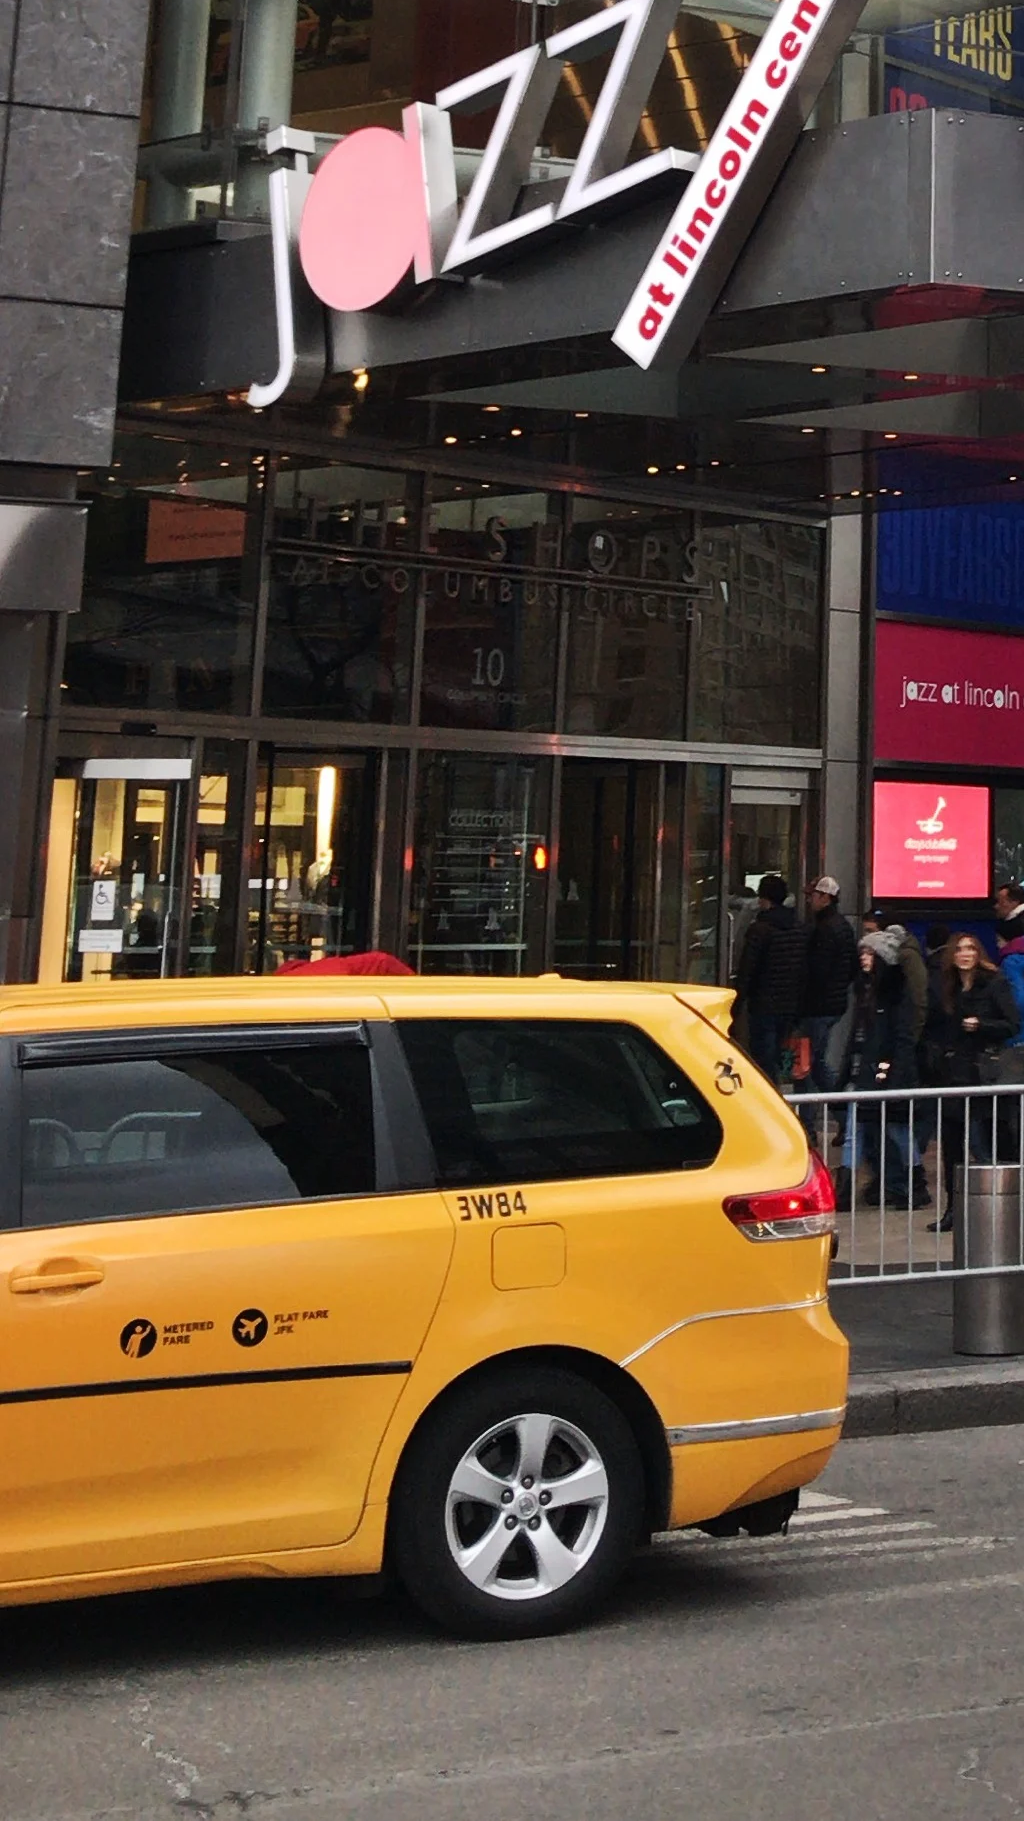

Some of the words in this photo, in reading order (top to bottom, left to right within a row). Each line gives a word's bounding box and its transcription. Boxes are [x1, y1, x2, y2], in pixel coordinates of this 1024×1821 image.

[638, 281, 675, 341] at
[662, 96, 769, 279] lincoln
[472, 646, 504, 687] 10
[900, 676, 938, 708] jazz
[941, 681, 961, 705] at
[964, 680, 1020, 711] lincoln
[457, 1191, 527, 1221] 3W84
[274, 1311, 299, 1324] FLAT
[302, 1309, 329, 1321] FARE
[163, 1321, 214, 1335] METERED
[274, 1325, 294, 1336] JFK
[163, 1335, 190, 1347] FARE
